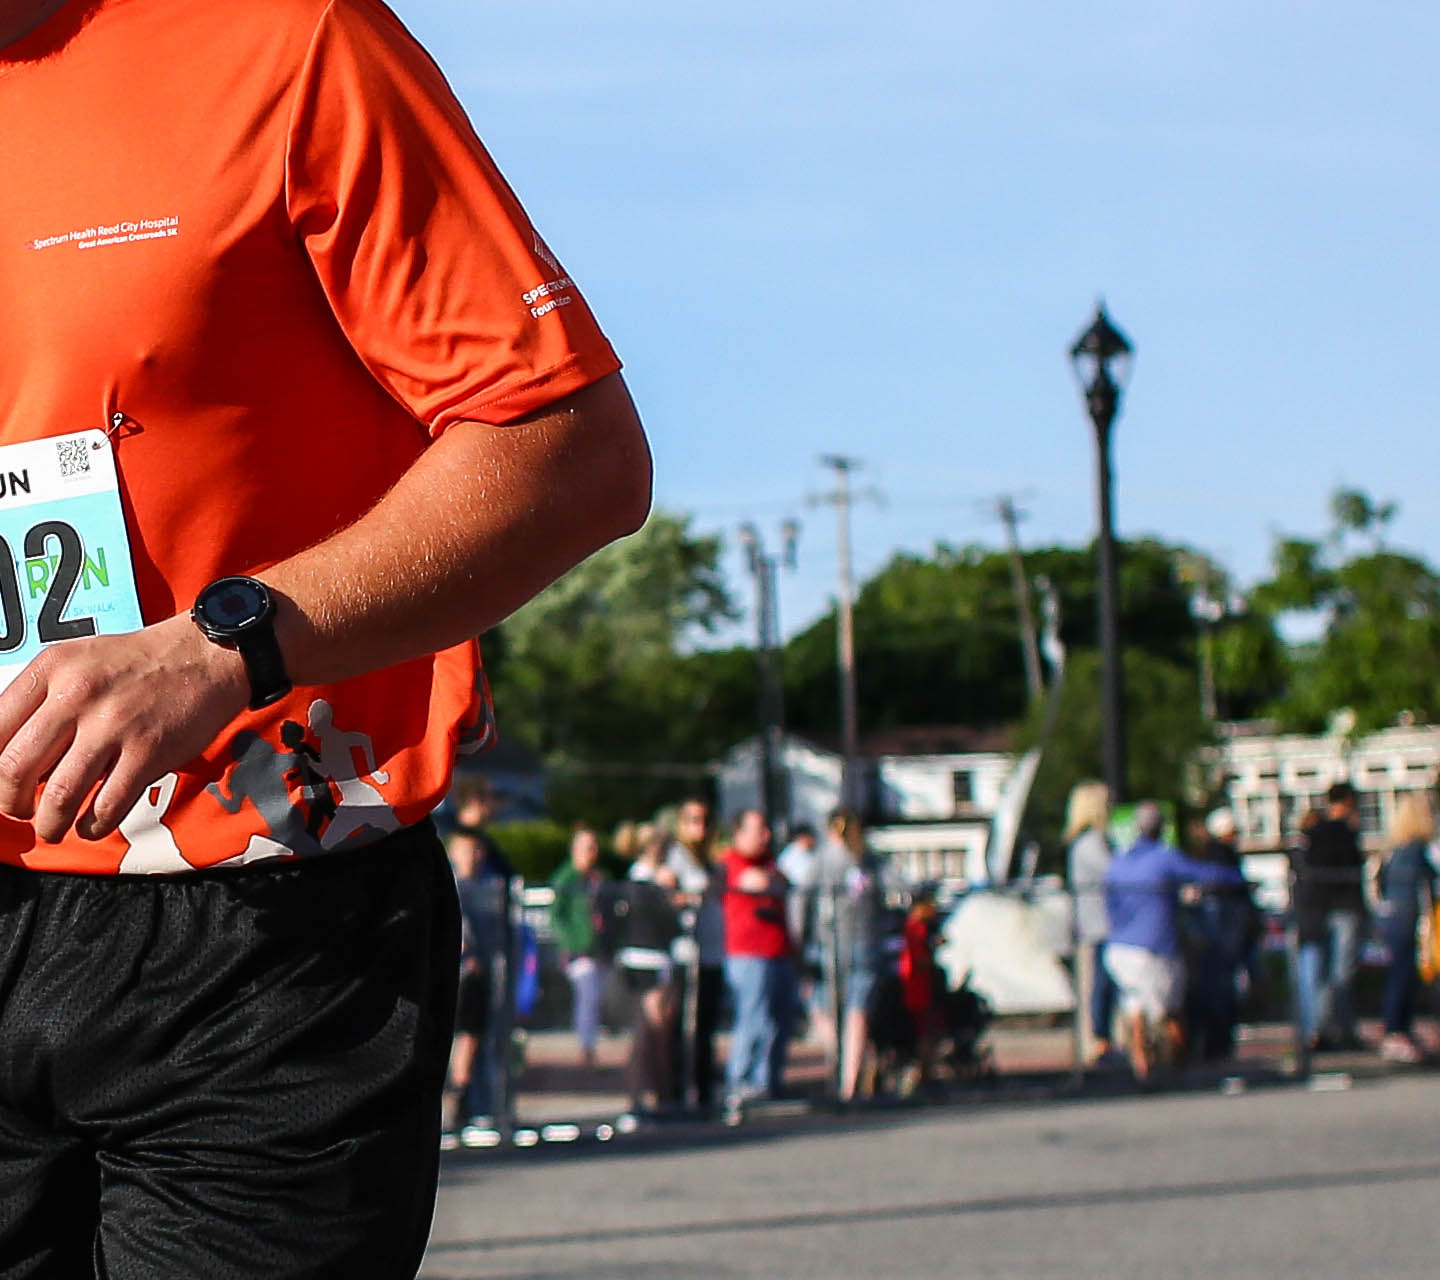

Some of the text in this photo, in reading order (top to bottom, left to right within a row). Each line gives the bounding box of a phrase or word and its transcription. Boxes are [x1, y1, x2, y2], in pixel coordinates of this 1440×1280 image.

[33, 215, 179, 251] Spectrum Health Reed City Hospital
[77, 239, 97, 250] Great
[96, 235, 128, 247] American
[128, 229, 167, 243] Crossroads
[25, 547, 110, 599] RN
